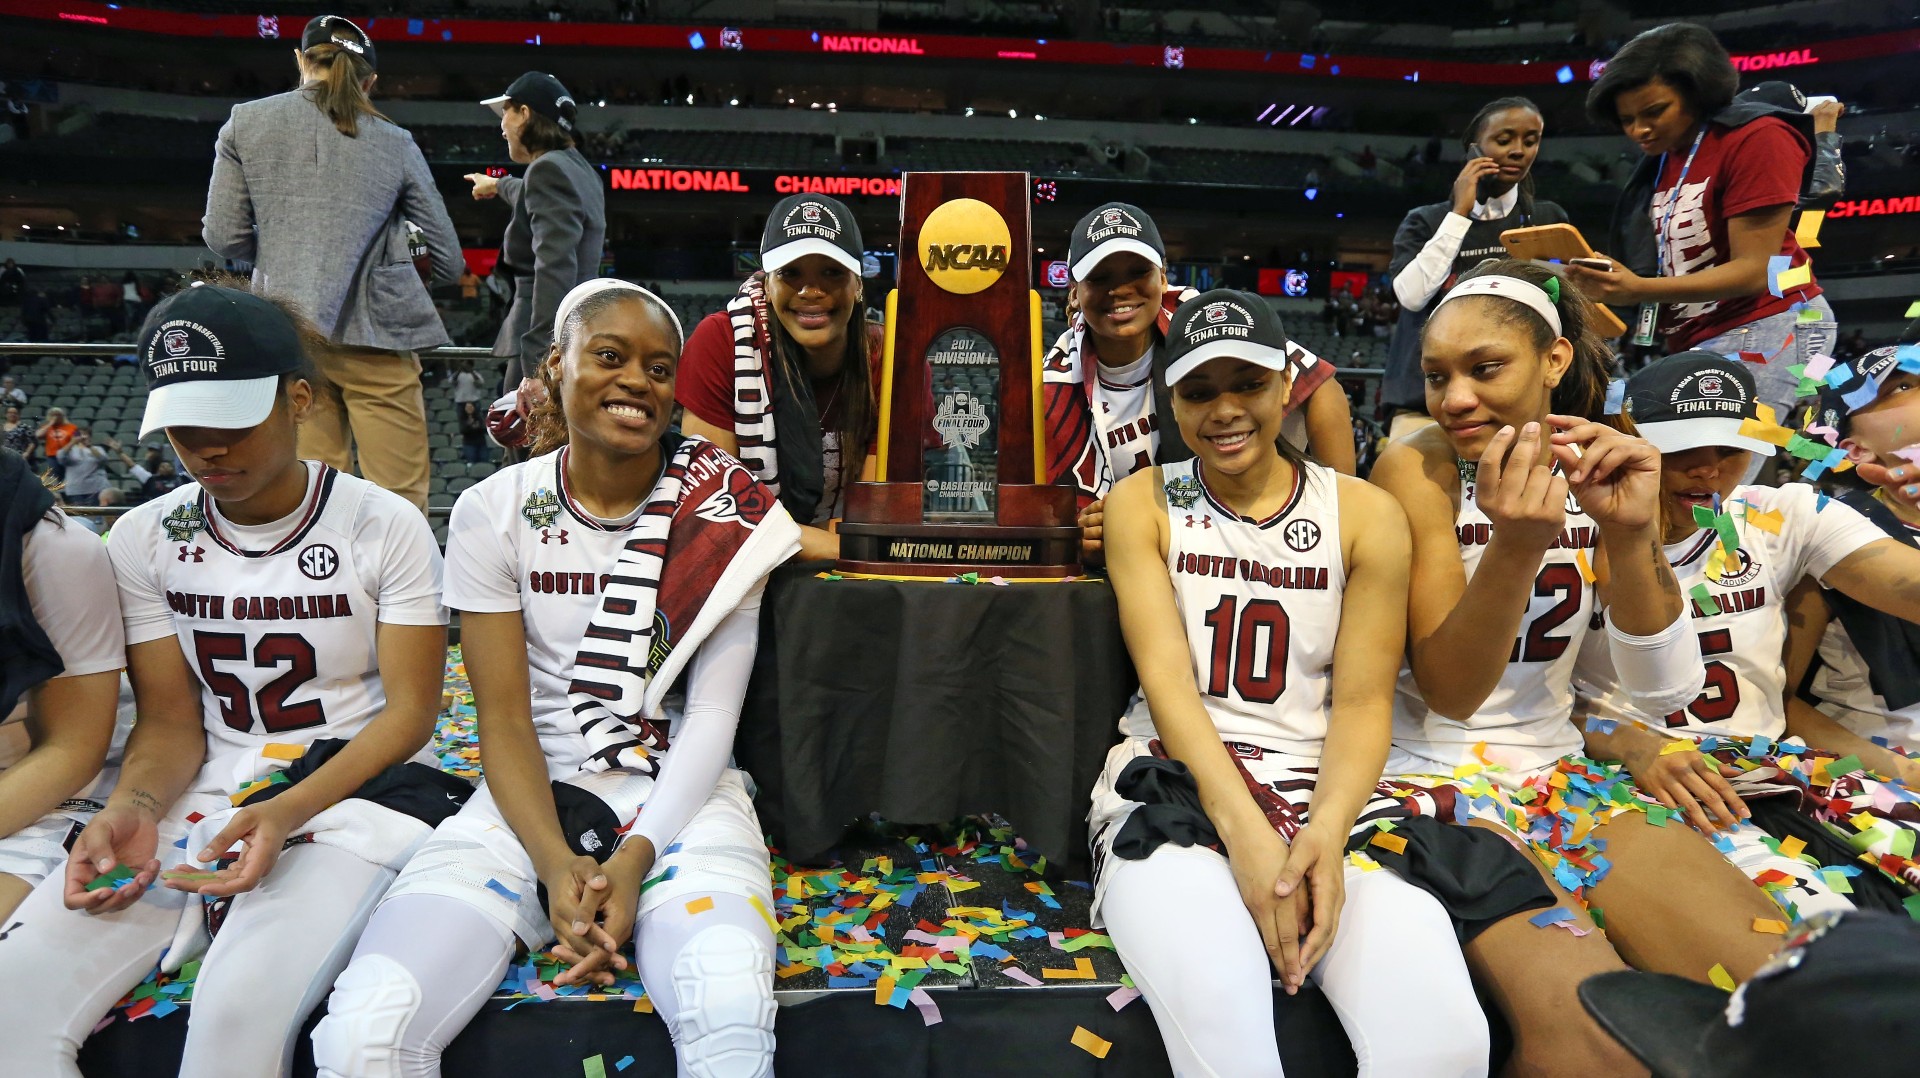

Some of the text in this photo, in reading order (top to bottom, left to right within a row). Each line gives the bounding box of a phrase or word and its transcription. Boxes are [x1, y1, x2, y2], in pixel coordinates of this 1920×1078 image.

[823, 36, 924, 54] NATIONAL
[1730, 49, 1819, 71] TIONAL
[610, 169, 749, 193] NATIONAL
[787, 225, 836, 241] FINAL FOUR
[1091, 226, 1138, 243] FINAL FOUR
[925, 244, 1008, 271] NCAA
[161, 320, 192, 331] WOMEN'S
[191, 322, 226, 357] BASKETBALL
[951, 339, 975, 350] 2017
[1190, 326, 1248, 345] FINAL FOUR
[934, 351, 985, 365] DIVISION
[153, 360, 218, 379] FINAL FOUR
[1693, 368, 1725, 377] WOMEN'S
[1724, 371, 1747, 401] BASKETBALL
[1676, 401, 1742, 414] FINAL FOUR
[937, 419, 985, 428] FINAL FOUR
[1107, 422, 1137, 449] UTH
[938, 490, 983, 498] CHAMPIONS
[940, 481, 992, 492] BASKETBALL
[526, 507, 544, 516] FINAL
[166, 520, 187, 528] FINAL
[1286, 521, 1319, 550] SEC
[301, 545, 336, 577] SEC
[889, 542, 1031, 561] NATIONAL CHAMPION
[1176, 550, 1237, 579] SOUTH
[530, 570, 595, 595] SOUTH
[1718, 571, 1756, 586] RADUATE
[166, 589, 353, 621] SOUTH CAROLINA
[1508, 563, 1582, 663] 2
[1205, 594, 1290, 705] 10
[193, 628, 327, 734] 52
[1664, 627, 1741, 729] 5
